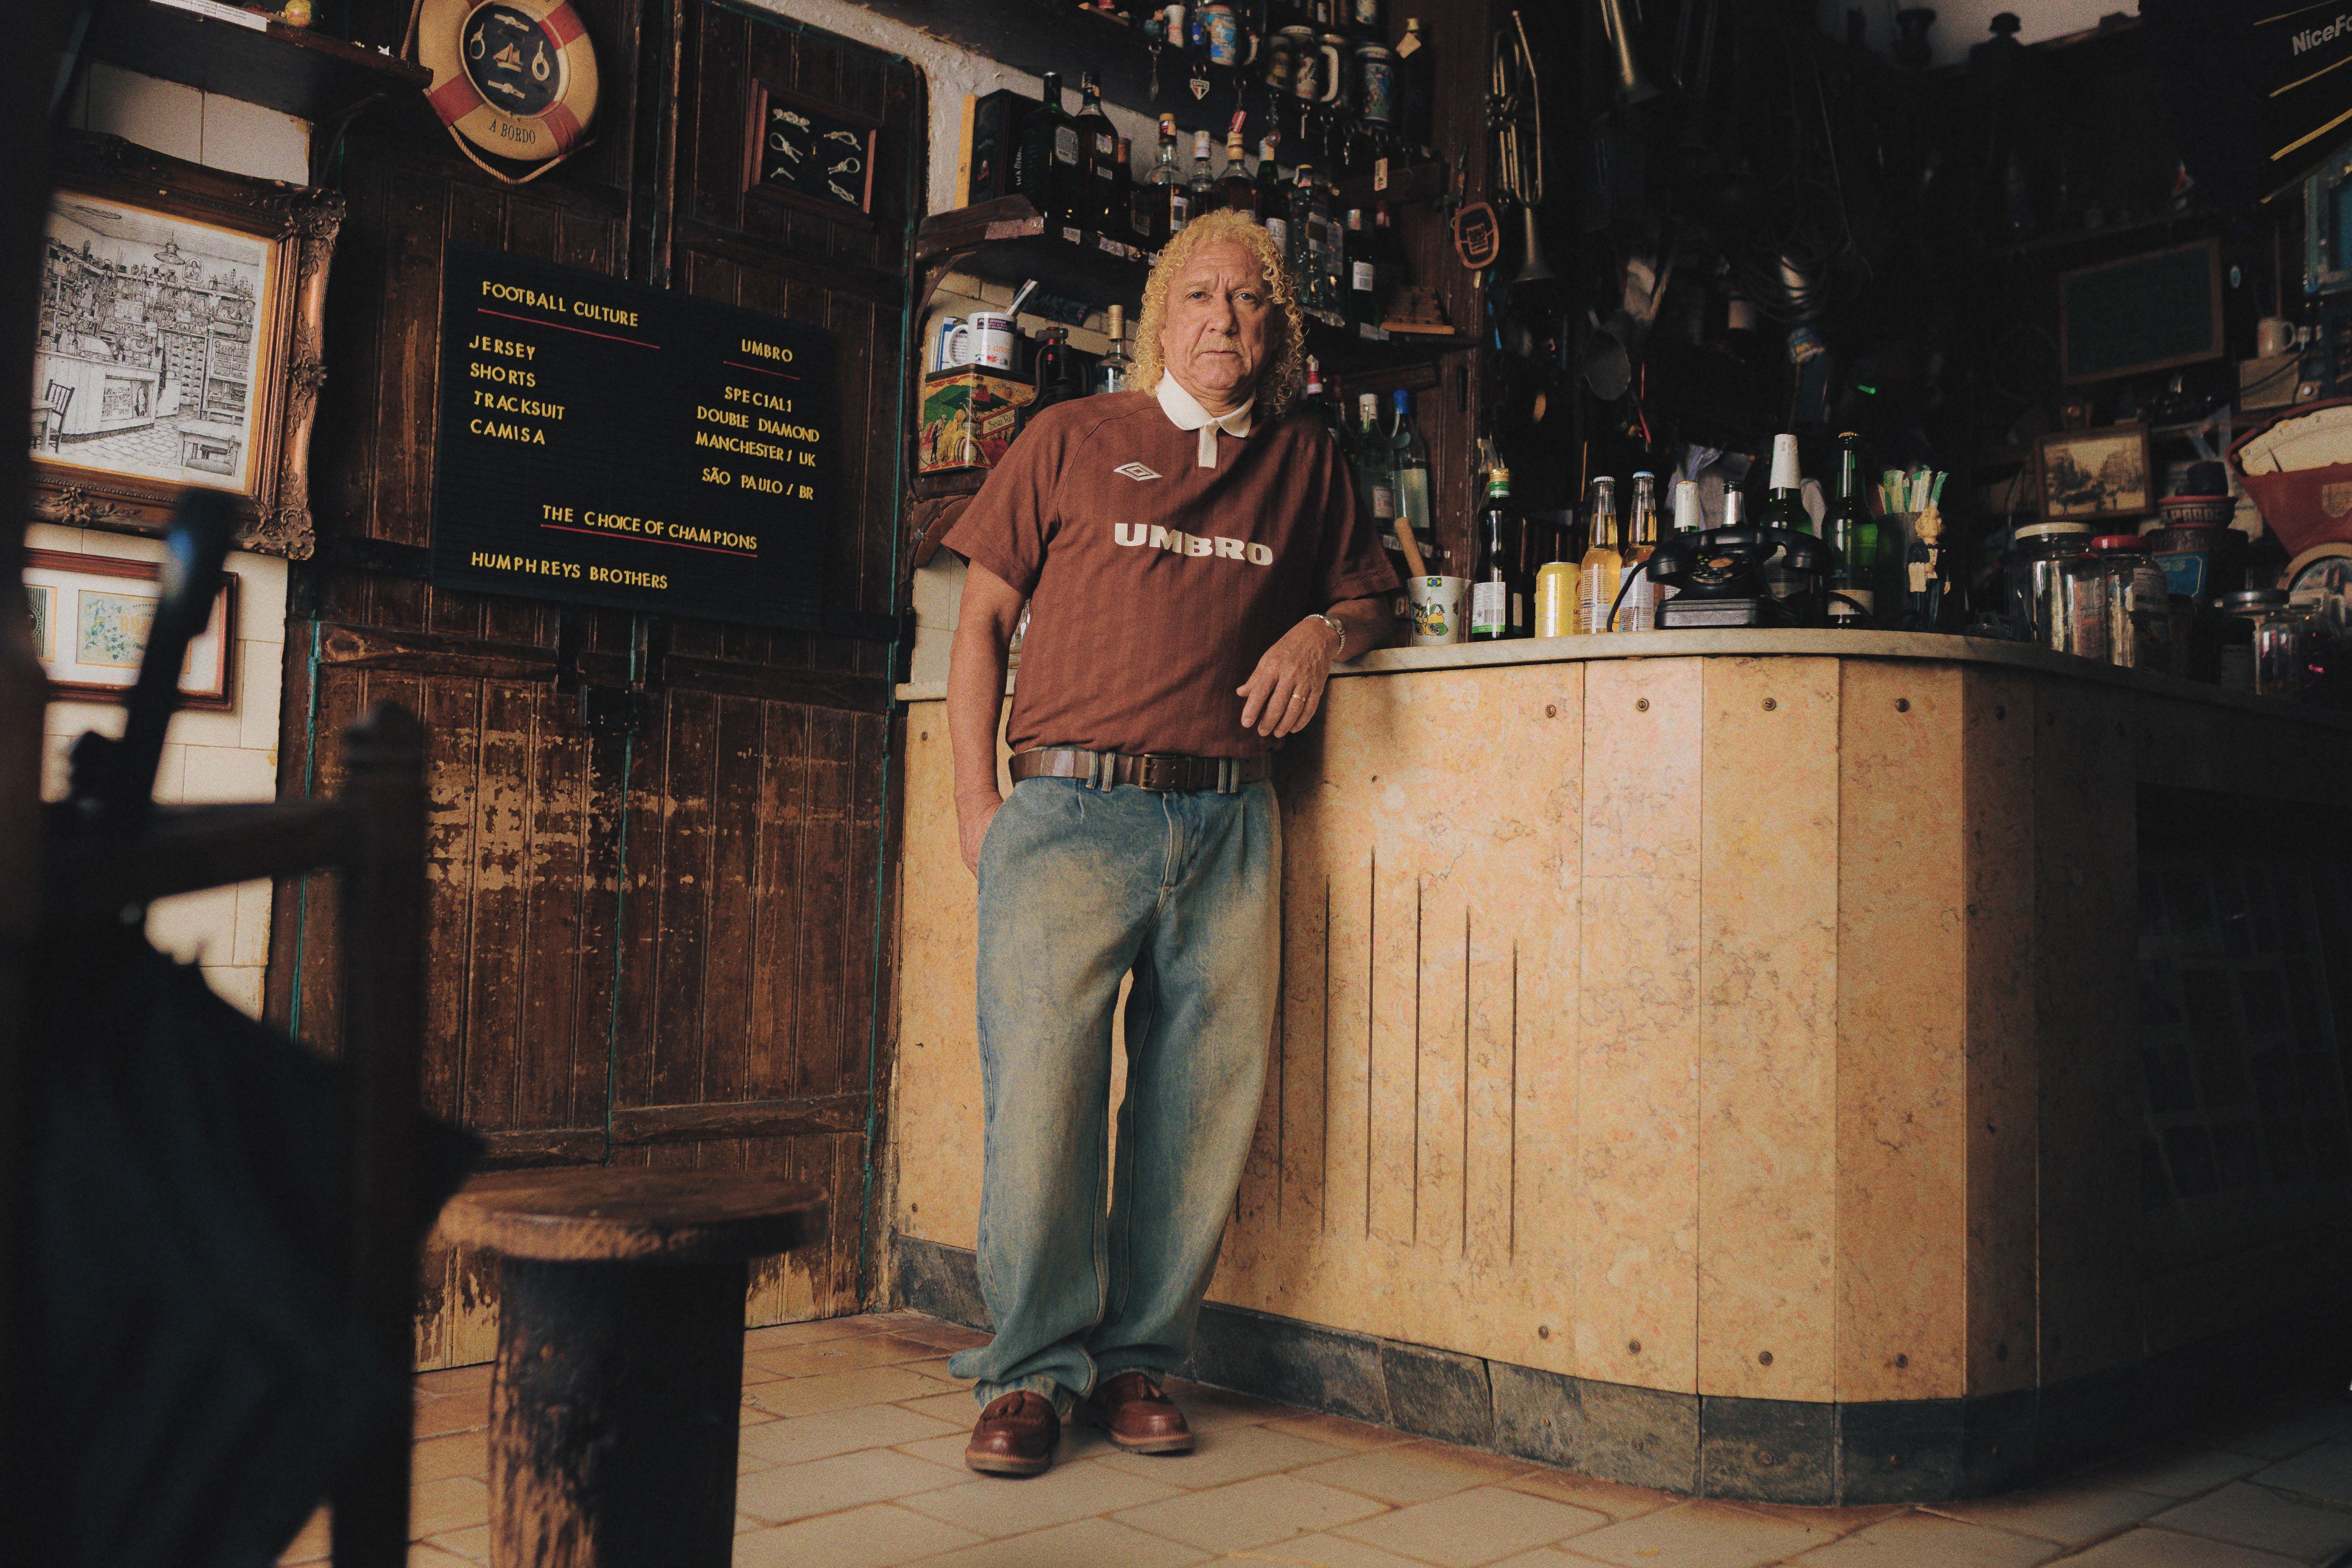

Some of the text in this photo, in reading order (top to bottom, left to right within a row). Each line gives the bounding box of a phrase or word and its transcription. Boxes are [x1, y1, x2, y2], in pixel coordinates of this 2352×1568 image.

[489, 118, 536, 144] A BORDO
[483, 281, 638, 326] FOOTBALL CULTURE
[469, 335, 535, 360] JERSEY
[742, 339, 793, 362] UMBRO
[470, 362, 536, 387] SHORTS
[473, 390, 565, 421] TRACKSUIT
[1002, 414, 1015, 423] Re
[470, 419, 545, 445] CAMISA
[697, 406, 819, 442] DOUBLE DIAMOND
[695, 431, 784, 462] MANCHESTER
[799, 452, 815, 467] UK
[702, 467, 731, 485] SÃO
[741, 475, 783, 493] PAULO
[799, 485, 813, 500] BR
[543, 505, 757, 549] THE CHOICE OF CHAMPIONS
[1114, 523, 1273, 566] UMBRO
[471, 552, 667, 589] HUMPHREYS BROTHERS
[119, 614, 153, 634] BRA
